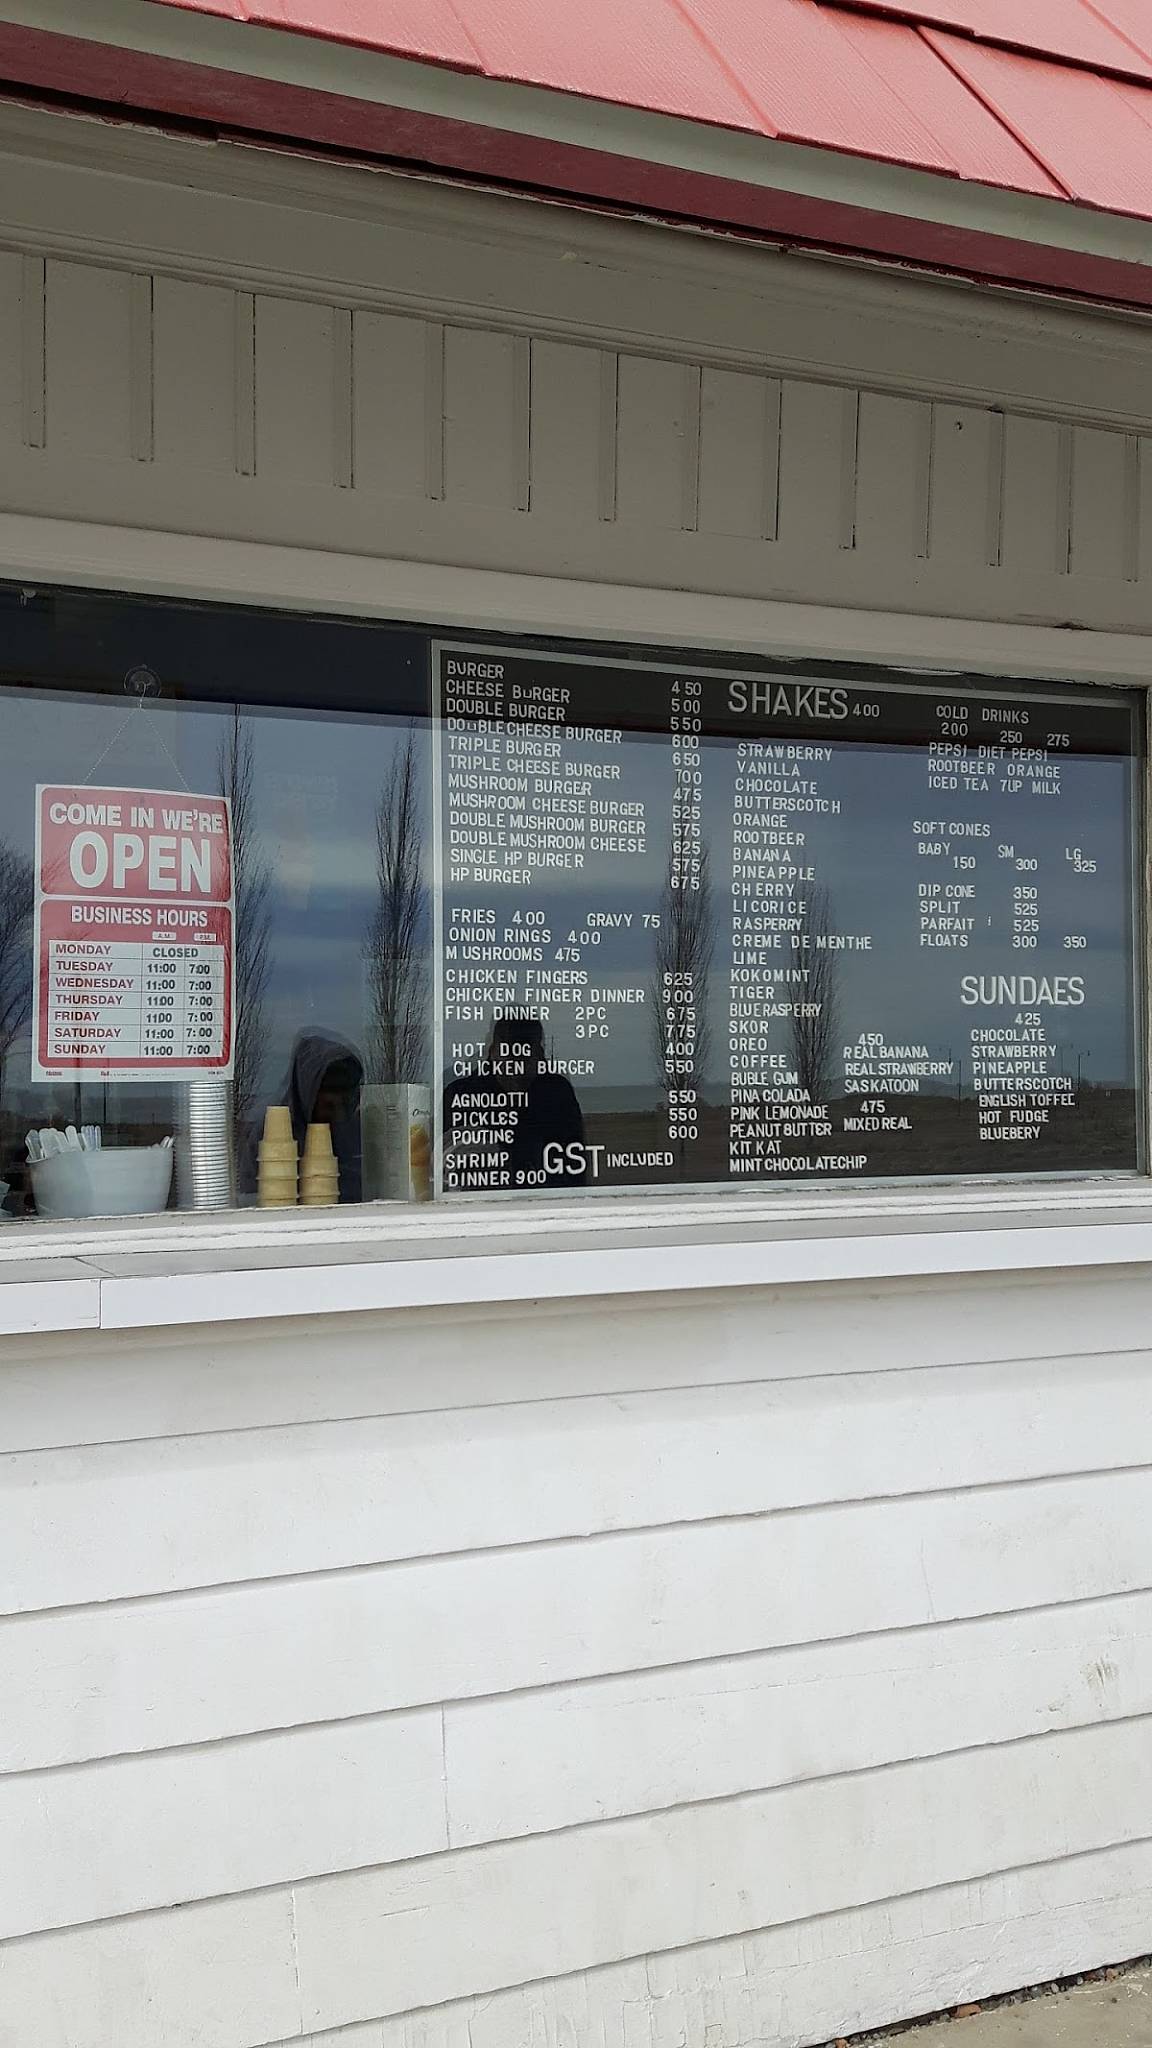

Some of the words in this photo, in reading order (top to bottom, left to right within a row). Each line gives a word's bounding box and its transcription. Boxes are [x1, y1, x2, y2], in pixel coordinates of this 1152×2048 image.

[447, 661, 504, 679] BURGER
[446, 680, 504, 698] CHEESE
[728, 680, 848, 719] SHAKES
[852, 703, 880, 717] 400
[446, 698, 503, 717] DOUBLE
[509, 703, 566, 721] BURGER
[936, 705, 968, 720] COLD
[982, 708, 1029, 724] DRINKS
[507, 721, 561, 739] CHEESE
[566, 727, 622, 744] BURGER
[1000, 730, 1023, 744] 250
[1047, 734, 1070, 747] 275
[448, 736, 501, 753] TRIPLE
[507, 740, 561, 757] BURGER
[979, 745, 1006, 759] DIET
[1012, 748, 1048, 762] PEPSI
[448, 754, 501, 772] TRIPLE
[507, 759, 561, 776] CHEESE
[565, 763, 620, 780] BURGER
[737, 761, 800, 776] VANILLA
[928, 759, 995, 774] ROOTBEER
[1007, 764, 1060, 779] ORANGE
[448, 773, 528, 792] MUSHROOM
[535, 780, 592, 796] BURGER
[736, 778, 817, 795] CHOCOLATE
[928, 776, 957, 789] ICED
[964, 777, 989, 791] TEA
[1032, 782, 1061, 795] MILK
[448, 792, 526, 810] MUSHROOM
[532, 798, 586, 814] CHEESE
[590, 801, 644, 817] BURGER
[50, 802, 122, 827] COME
[131, 807, 154, 828] IN
[162, 809, 224, 833] WE'RE
[672, 806, 700, 819] 525
[450, 811, 505, 828] DOUBLE
[510, 815, 584, 831] MUSHROOM
[590, 819, 646, 835] BURGER
[733, 813, 787, 828] ORANGE
[672, 823, 700, 837] 575
[913, 821, 947, 835] SOFT
[949, 823, 991, 837] CONES
[450, 830, 507, 847] DOUBLE
[510, 834, 585, 850] MUSHROOM
[591, 837, 646, 853] CHEESE
[673, 841, 701, 854] 625
[450, 849, 497, 864] SINGLE
[504, 851, 522, 866] HP
[528, 852, 584, 868] BURGER
[918, 842, 951, 855] BABY
[998, 845, 1014, 858] SM
[1066, 848, 1082, 860] LG
[69, 831, 211, 893] OPEN
[672, 859, 700, 872] 575
[953, 856, 976, 869] 150
[1016, 858, 1038, 871] 300
[1073, 860, 1097, 873] 325
[451, 868, 469, 882] HP
[474, 869, 531, 885] BURGER
[733, 865, 815, 880] PINEAPPLE
[671, 876, 700, 889] 675
[918, 884, 941, 897] DIP
[946, 884, 976, 898] CONE
[1013, 887, 1037, 899] 350
[920, 901, 961, 914] SPLIT
[1014, 903, 1038, 916] 525
[71, 906, 152, 925] BUSINESS
[157, 909, 208, 927] HOURS
[451, 909, 496, 924] FRIES
[587, 913, 633, 928] GRAVY
[643, 914, 661, 928] 75
[733, 917, 803, 930] RASPERRY
[920, 917, 975, 930] PARFAIT
[1014, 920, 1039, 932] 525
[449, 928, 496, 942] ONION
[504, 928, 551, 943] RINGS
[732, 934, 781, 948] CREME
[791, 935, 810, 948] DE
[816, 936, 872, 950] MENTHE
[920, 934, 968, 947] FLOATS
[1012, 935, 1037, 948] 300
[1064, 936, 1087, 949] 350
[56, 944, 111, 955] MONDAY
[153, 948, 198, 958] CLOSED
[555, 947, 581, 962] 475
[733, 952, 767, 965] LIME
[56, 961, 113, 971] TUESDAY
[147, 964, 176, 973] 11:00
[446, 969, 517, 984] CHICKEN
[526, 970, 588, 985] FINGERS
[664, 972, 693, 986] 625
[730, 969, 810, 982] KOKOMINT
[56, 978, 134, 989] WEDNESDAY
[146, 980, 175, 990] 11:00
[189, 981, 211, 990] 7:00
[960, 975, 1085, 1006] SUNDAES
[446, 988, 515, 1002] CHICKEN
[525, 989, 582, 1002] FINGER
[591, 989, 645, 1003] DINNER
[730, 986, 774, 999] TIGER
[56, 995, 123, 1005] THURSDAY
[190, 996, 212, 1006] 7:00
[55, 1012, 100, 1021] FRIDAY
[445, 1005, 484, 1020] FISH
[493, 1006, 550, 1020] DINNER
[1015, 1012, 1041, 1026] 425
[55, 1028, 121, 1038] SATURDAY
[145, 1030, 174, 1039] 11:00
[729, 1021, 769, 1034] SKOR
[859, 1034, 883, 1046] 450
[971, 1029, 1046, 1042] CHOCOLATE
[55, 1045, 106, 1054] SUNDAY
[144, 1046, 173, 1056] 11:00
[187, 1045, 210, 1054] 7:00
[453, 1043, 485, 1057] HOT
[500, 1043, 532, 1057] DOG
[666, 1043, 694, 1056] 400
[729, 1038, 767, 1050] OREO
[971, 1045, 1057, 1058] STRAWBERRY
[879, 1046, 929, 1059] BANANA
[537, 1061, 595, 1075] BURGER
[665, 1060, 694, 1073] 550
[730, 1055, 787, 1068] COFFEE
[973, 1061, 1047, 1075] PINEAPPLE
[845, 1063, 876, 1076] REAL
[844, 1078, 919, 1093] SASKATOON
[974, 1078, 1072, 1091] BUTTERSCOTCH
[451, 1092, 528, 1108] AGNOLOTTI
[668, 1090, 696, 1104] 550
[731, 1088, 760, 1103] PINA
[763, 1088, 811, 1102] COLADA
[731, 1106, 760, 1120] PINK
[765, 1105, 829, 1120] LEMONADE
[860, 1100, 885, 1114] 475
[453, 1111, 519, 1127] PICKLES
[669, 1108, 697, 1121] 550
[843, 1117, 879, 1132] MIXED
[882, 1117, 912, 1130] REAL
[979, 1111, 1002, 1124] HOT
[1010, 1110, 1049, 1123] FUDGE
[452, 1129, 514, 1145] POUTINE
[668, 1125, 698, 1139] 600
[730, 1123, 782, 1138] PEANUT
[980, 1126, 1041, 1140] BLUEBERY
[730, 1141, 751, 1155] KIT
[446, 1152, 509, 1169] SHRIMP
[543, 1142, 605, 1177] GST
[607, 1152, 674, 1168] INCLUDED
[449, 1171, 510, 1187] DINNER
[515, 1170, 547, 1185] 900
